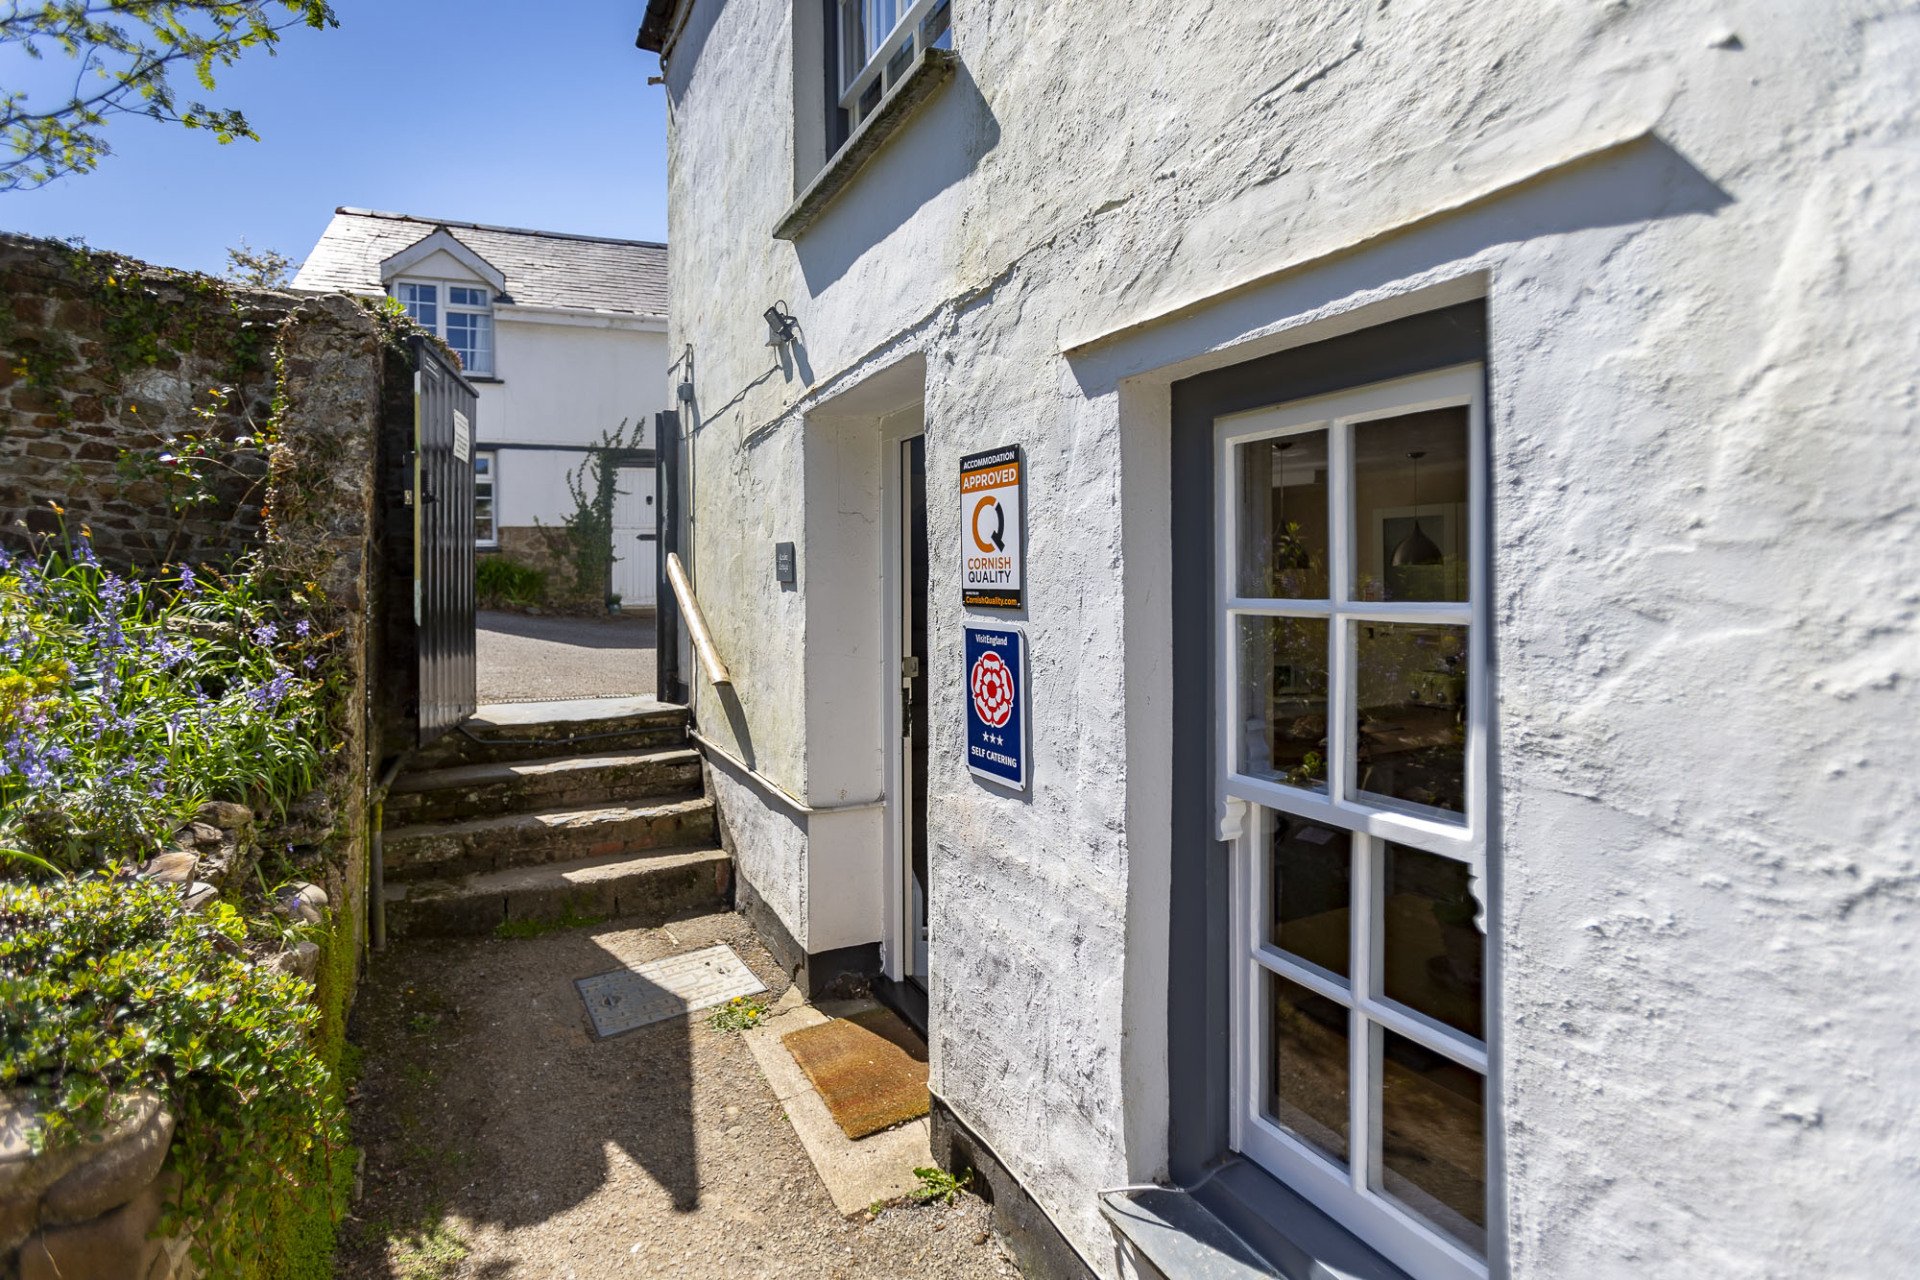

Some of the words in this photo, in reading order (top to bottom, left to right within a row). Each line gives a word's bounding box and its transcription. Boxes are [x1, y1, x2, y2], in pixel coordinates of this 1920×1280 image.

[963, 451, 1015, 470] ACCOMMODATION
[963, 469, 1017, 490] APPROVED
[968, 557, 1011, 570] CORNISH
[968, 570, 1011, 583] QUALITY
[966, 595, 1017, 606] CornishQuality.com
[975, 634, 1008, 646] VisitEngland
[971, 746, 986, 758] SELF
[986, 750, 1017, 768] CATERING
